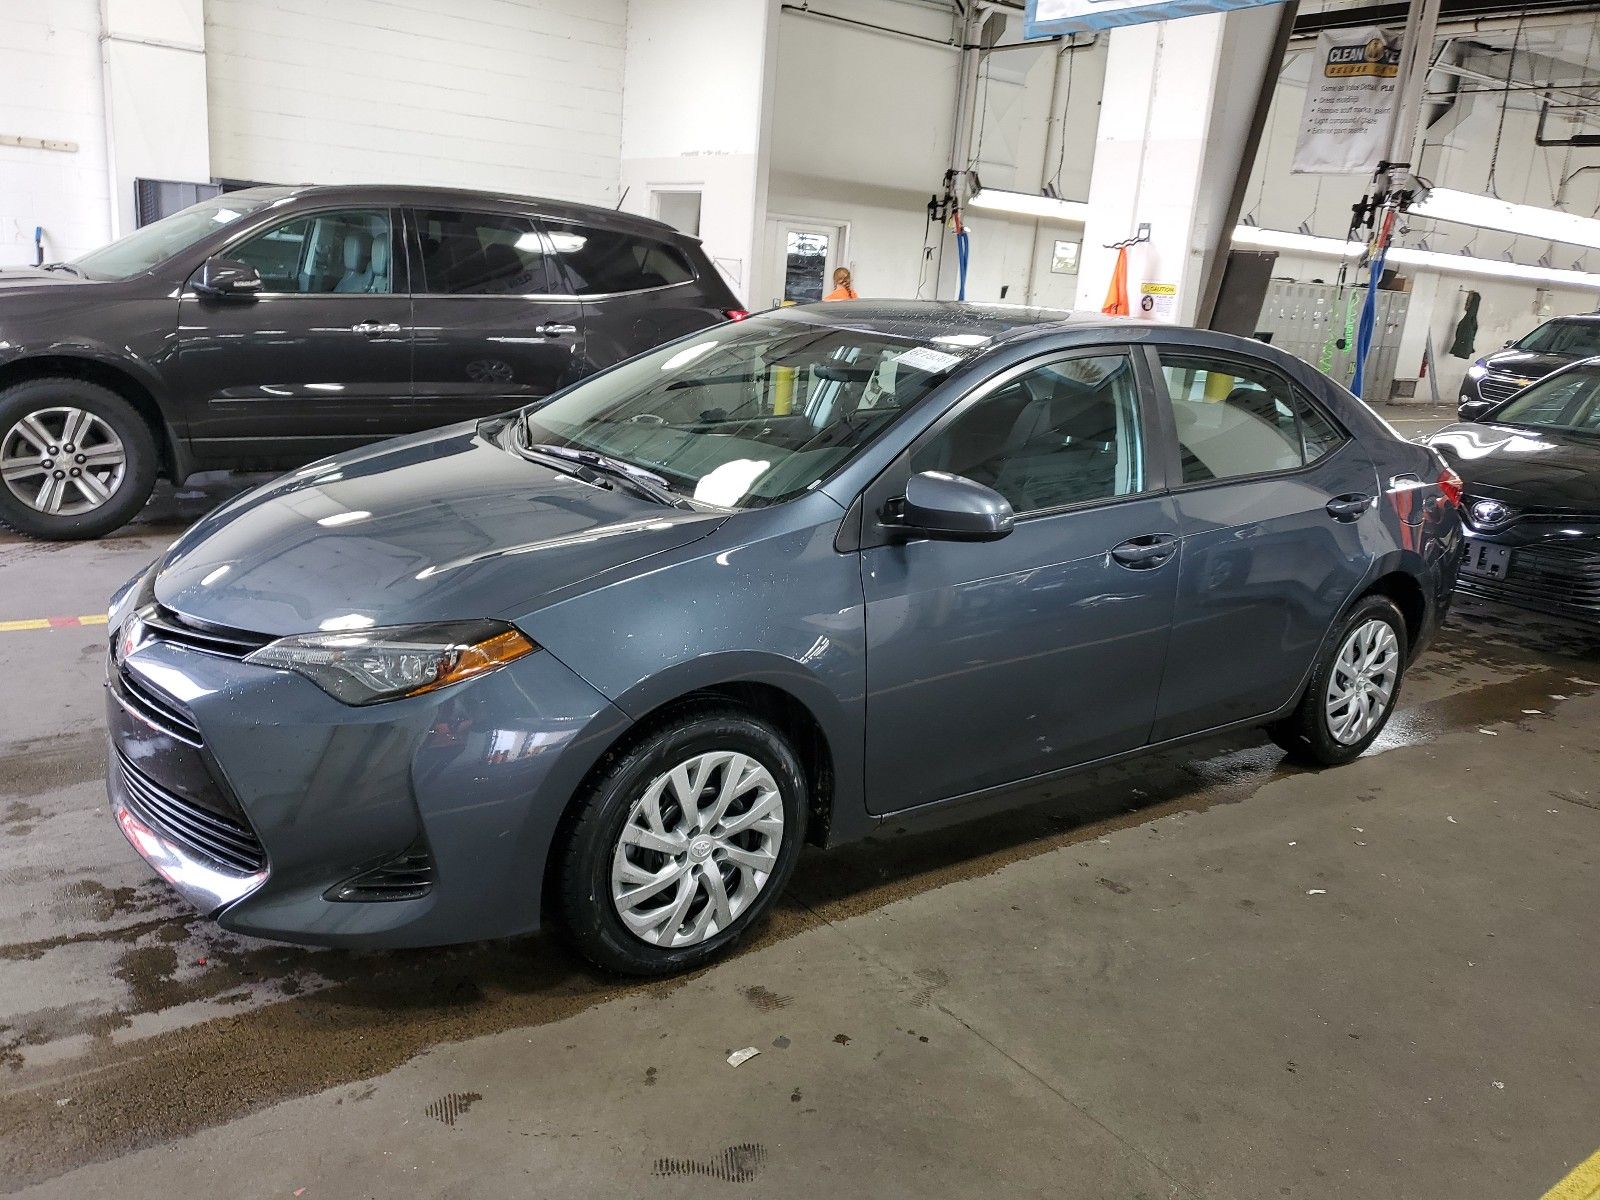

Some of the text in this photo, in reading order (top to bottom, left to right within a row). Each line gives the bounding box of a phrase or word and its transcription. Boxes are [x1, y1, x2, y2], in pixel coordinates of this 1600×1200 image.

[1329, 48, 1365, 63] CLEAN
[1330, 65, 1367, 74] DELUXE
[1321, 84, 1336, 92] Same
[1380, 84, 1395, 92] PLU
[1151, 285, 1175, 293] CAUTION
